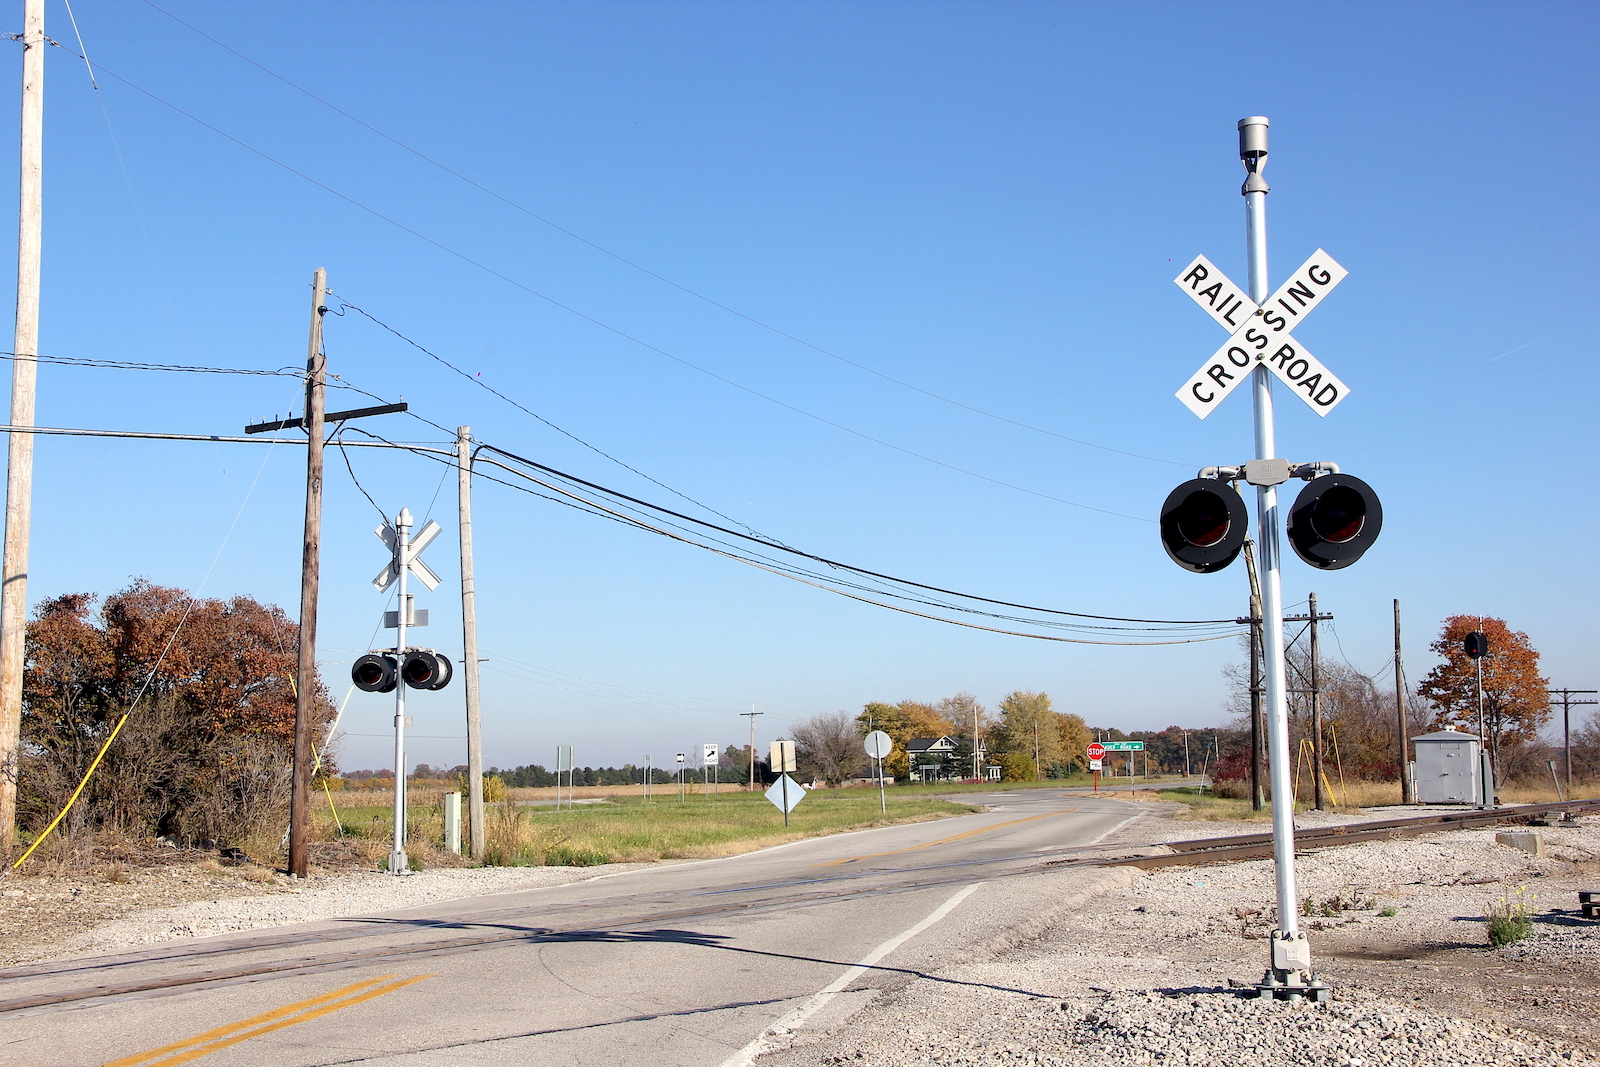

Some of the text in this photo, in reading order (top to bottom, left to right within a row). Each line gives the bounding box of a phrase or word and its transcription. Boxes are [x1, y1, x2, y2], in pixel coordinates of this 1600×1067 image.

[1183, 263, 1338, 407] RAIL ROAD
[1192, 264, 1332, 403] CROSSING
